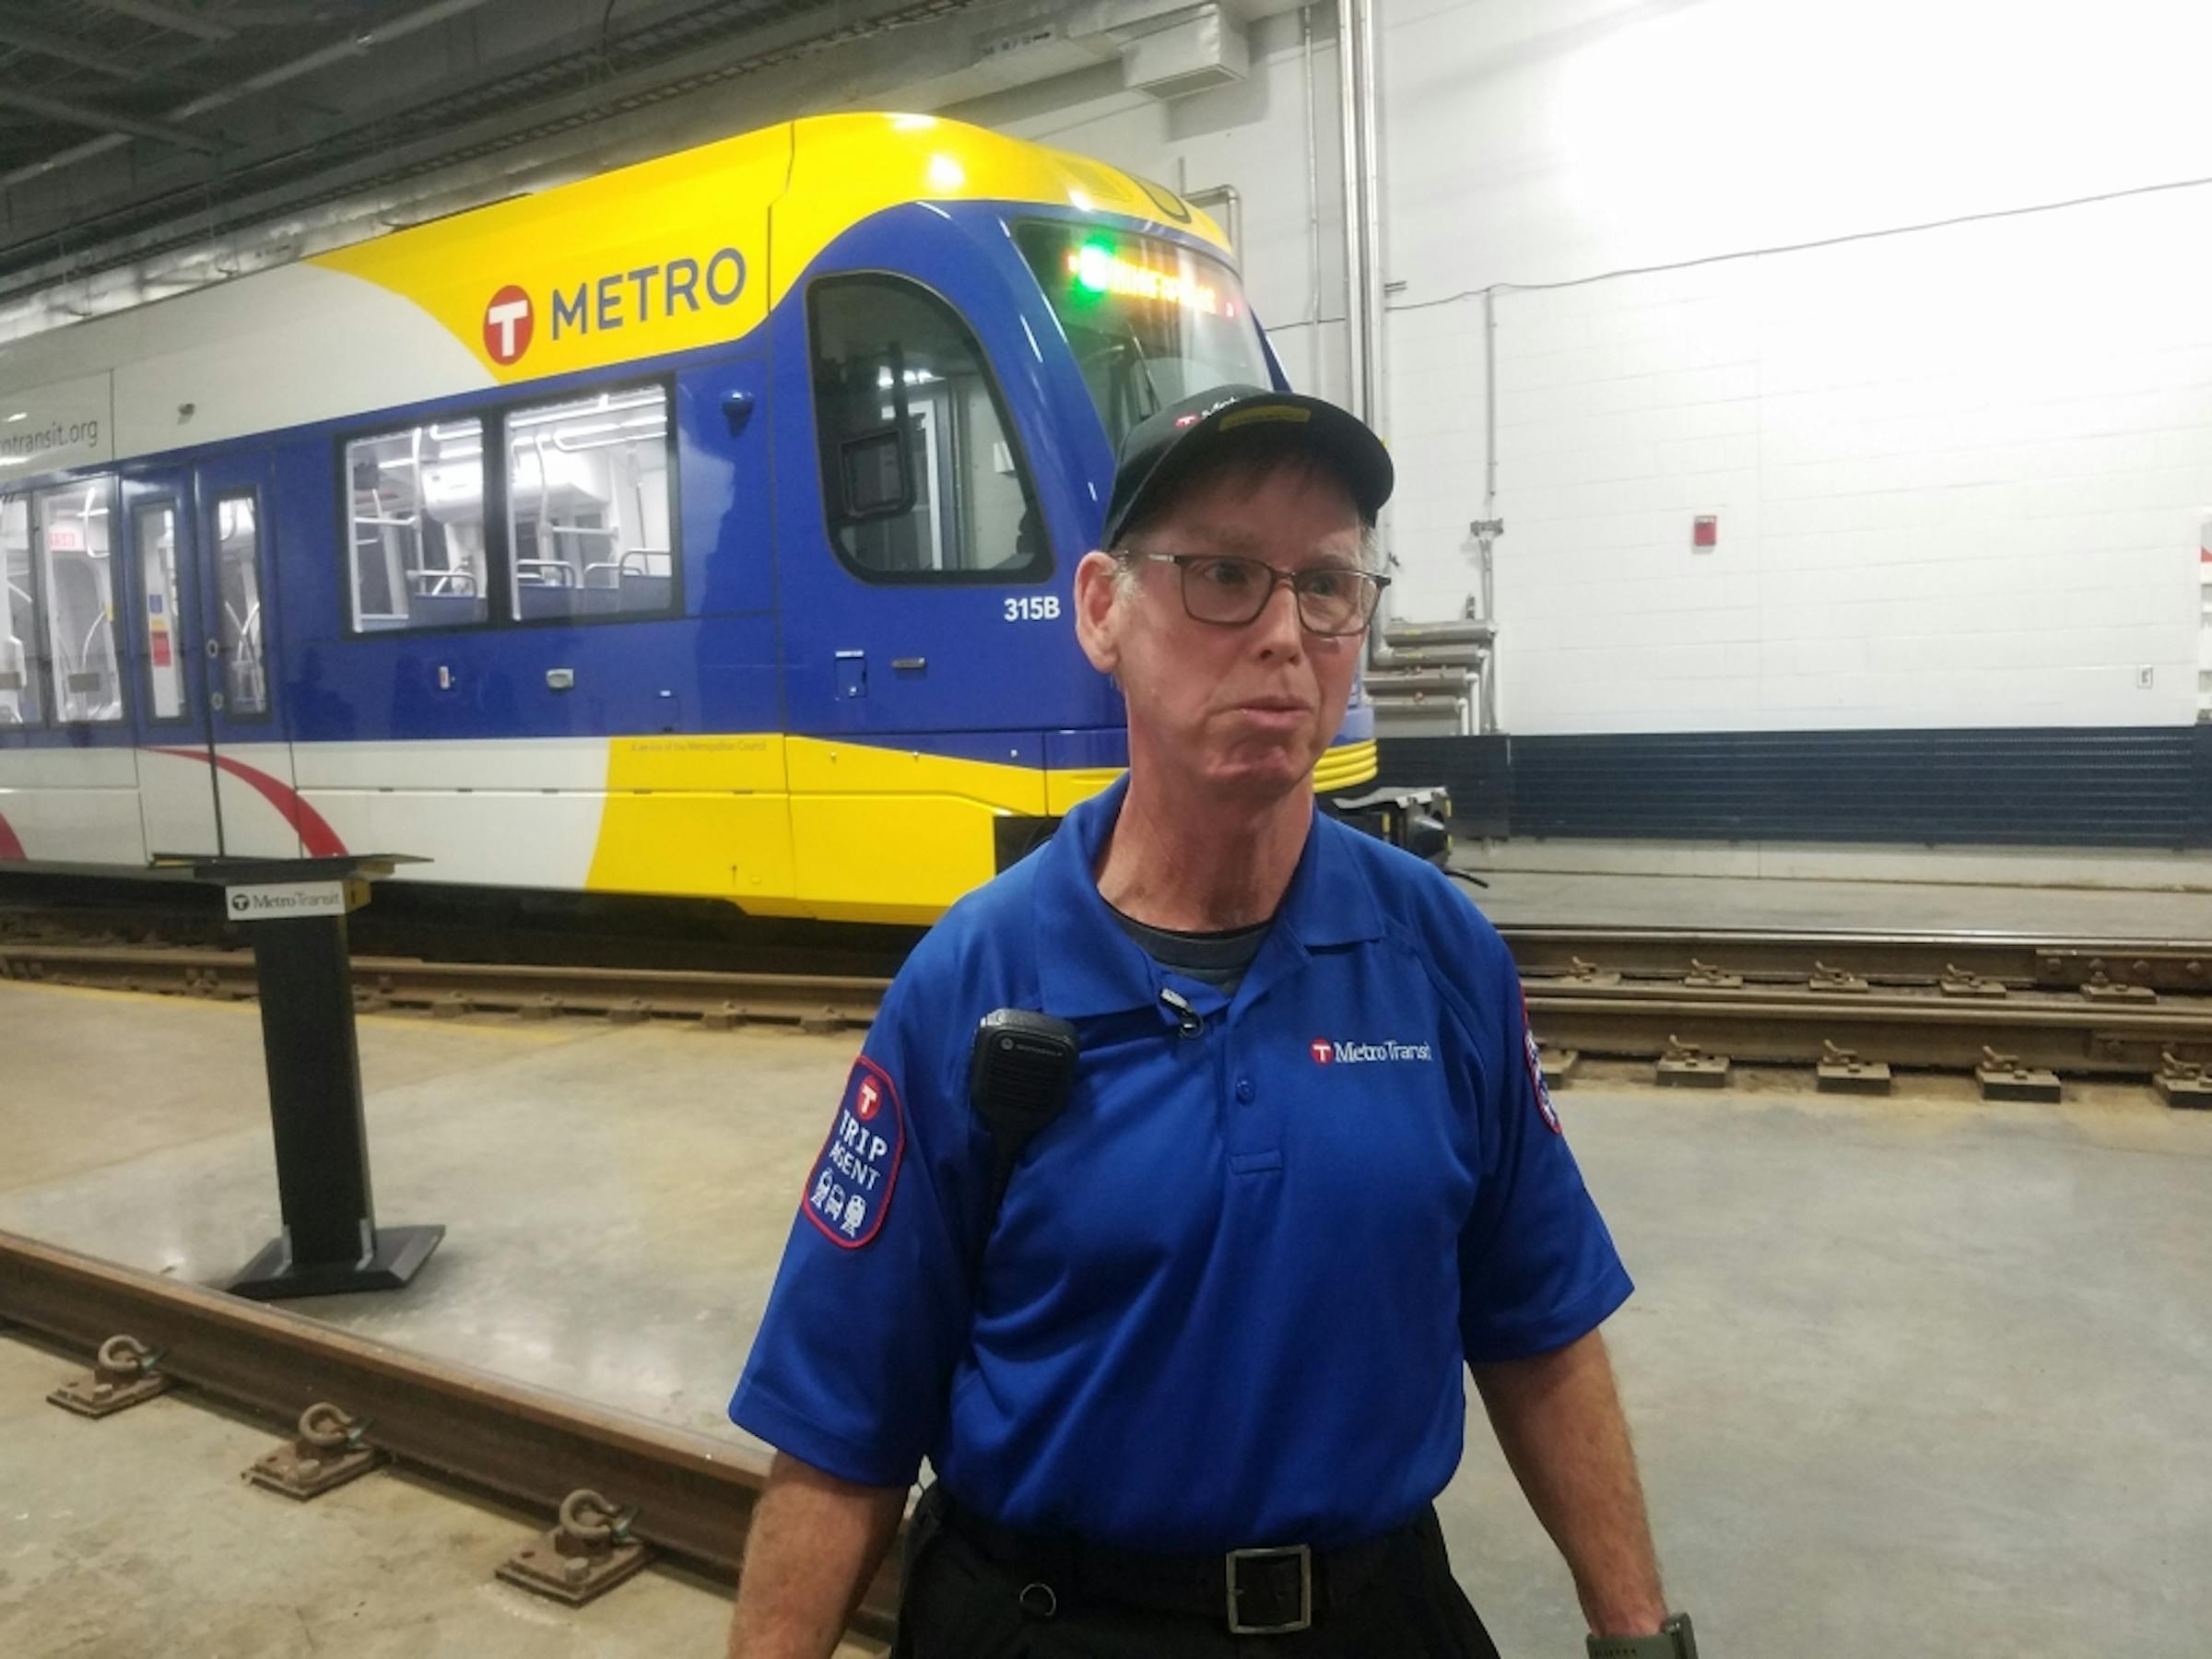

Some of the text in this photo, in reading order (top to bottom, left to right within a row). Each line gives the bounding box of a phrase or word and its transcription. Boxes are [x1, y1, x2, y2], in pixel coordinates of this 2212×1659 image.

[552, 247, 747, 341] METRO
[1004, 595, 1061, 622] 315B
[839, 1109, 888, 1162] TRIP
[830, 1139, 881, 1191] AGENT
